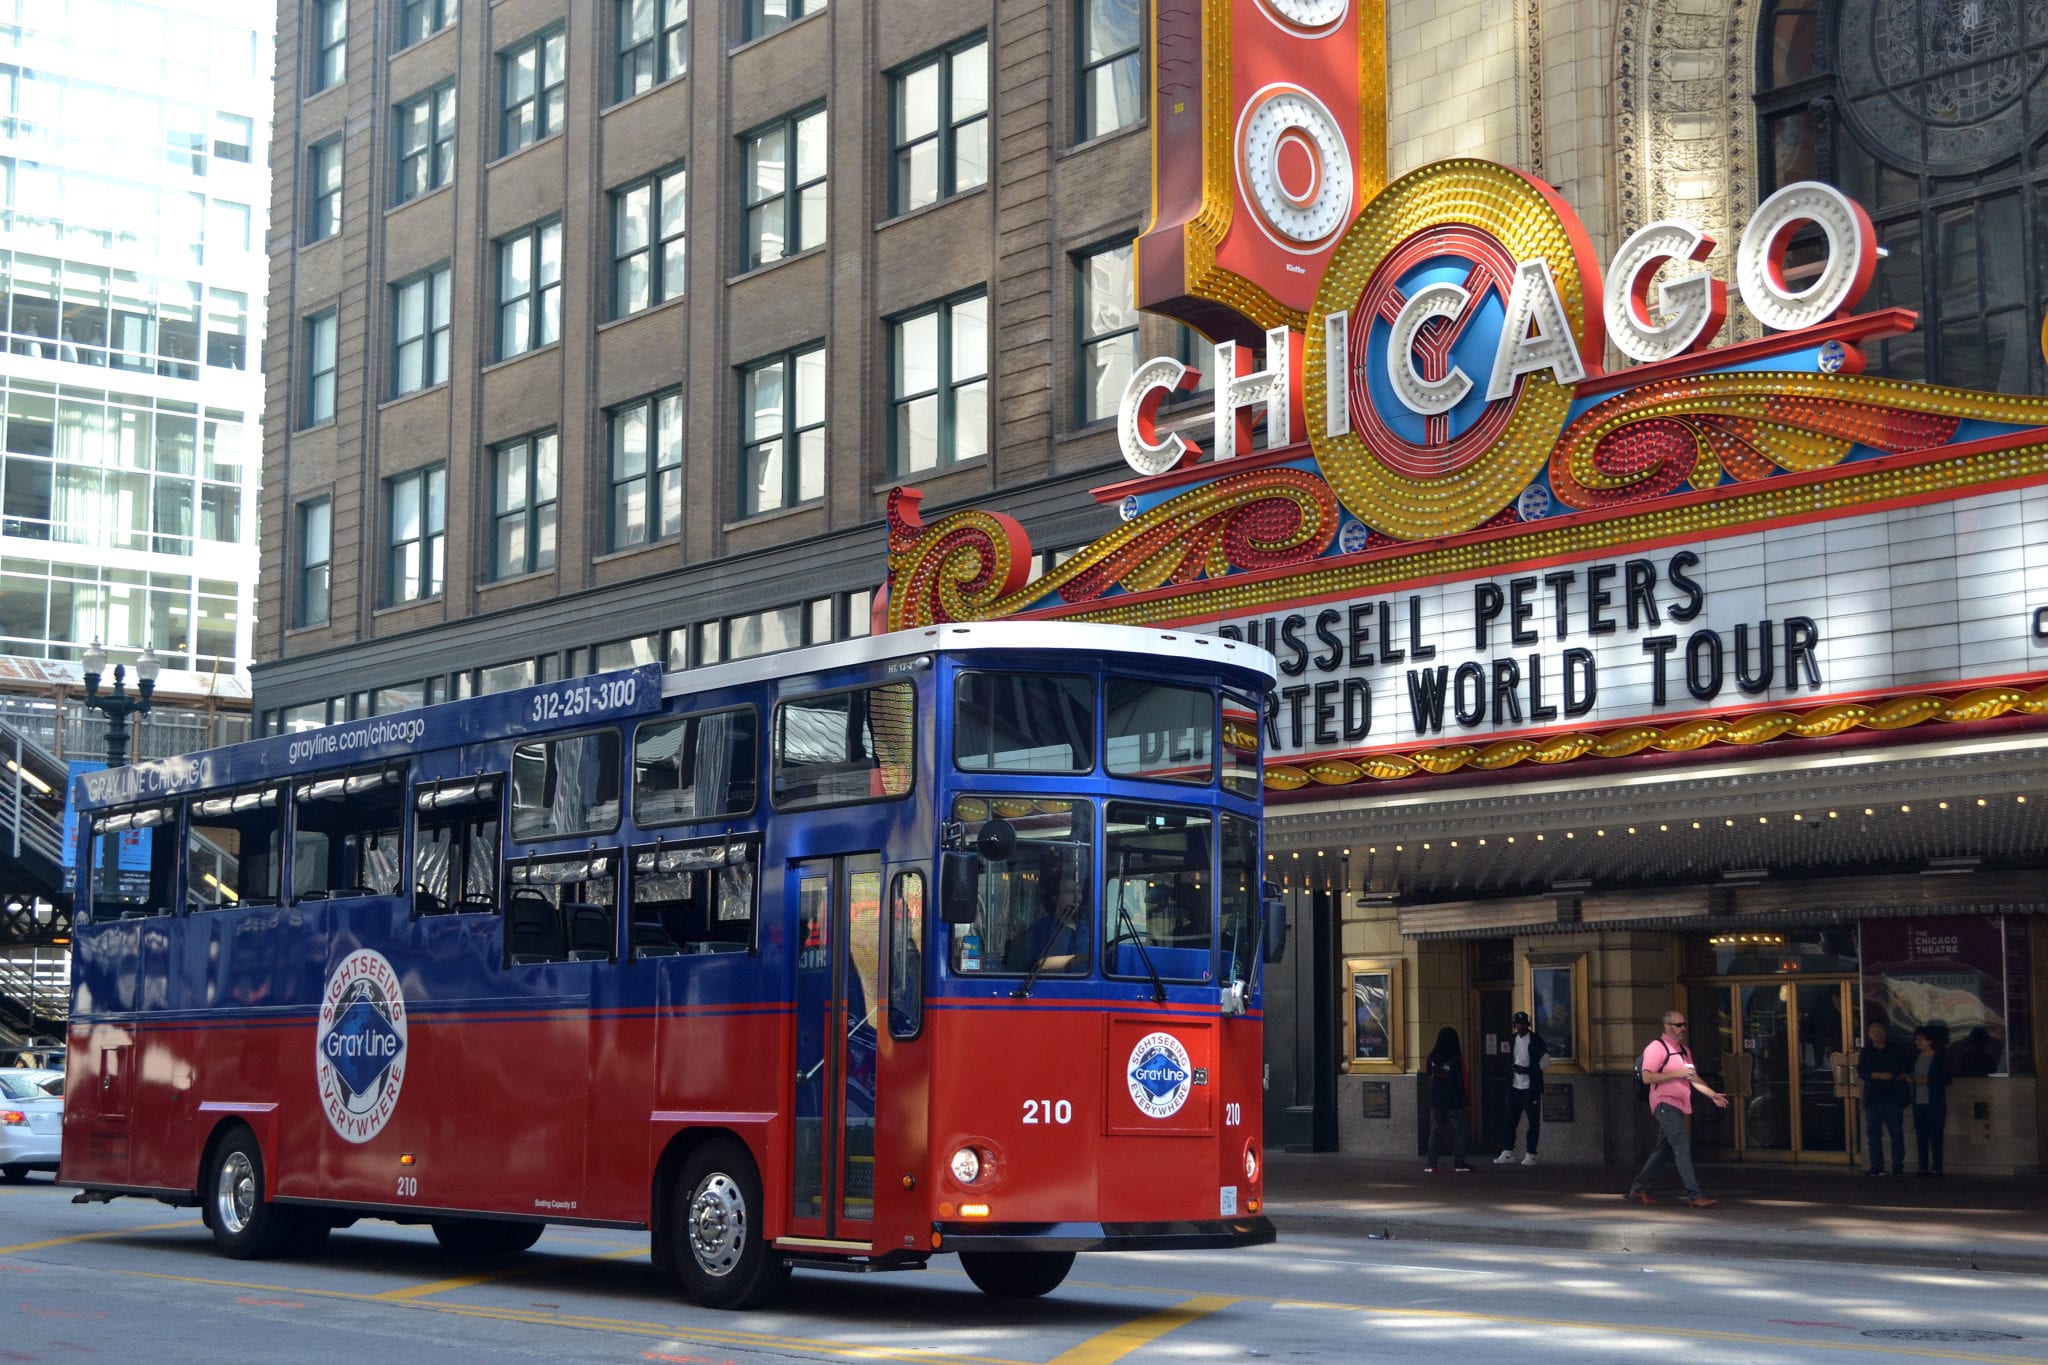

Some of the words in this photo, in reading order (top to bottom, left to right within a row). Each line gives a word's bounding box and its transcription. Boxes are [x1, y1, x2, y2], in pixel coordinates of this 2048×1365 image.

[1117, 181, 1876, 476] CHICAGO
[1218, 595, 1436, 677] SSELL
[1474, 550, 1704, 651] PETERS
[1406, 647, 1597, 735] WORLD
[1642, 615, 1823, 707] TOUR
[532, 678, 637, 723] 312-251-3100
[288, 717, 425, 764] grayline.com/chicago
[88, 774, 122, 802] GRAY
[121, 769, 145, 796] LINE
[149, 757, 212, 792] CHICAGO
[1914, 936, 1959, 946] CHICAGO
[1915, 945, 1959, 955] THEATRE
[323, 956, 402, 1022] SIGHTSEEING
[1132, 1035, 1188, 1067] SIGHTSEEING
[321, 1063, 403, 1138] EVERYWHERE
[1022, 1099, 1072, 1124] 210
[1130, 1082, 1189, 1116] EVERYWHERE
[1225, 1102, 1241, 1126] 210
[397, 1176, 418, 1197] 210
